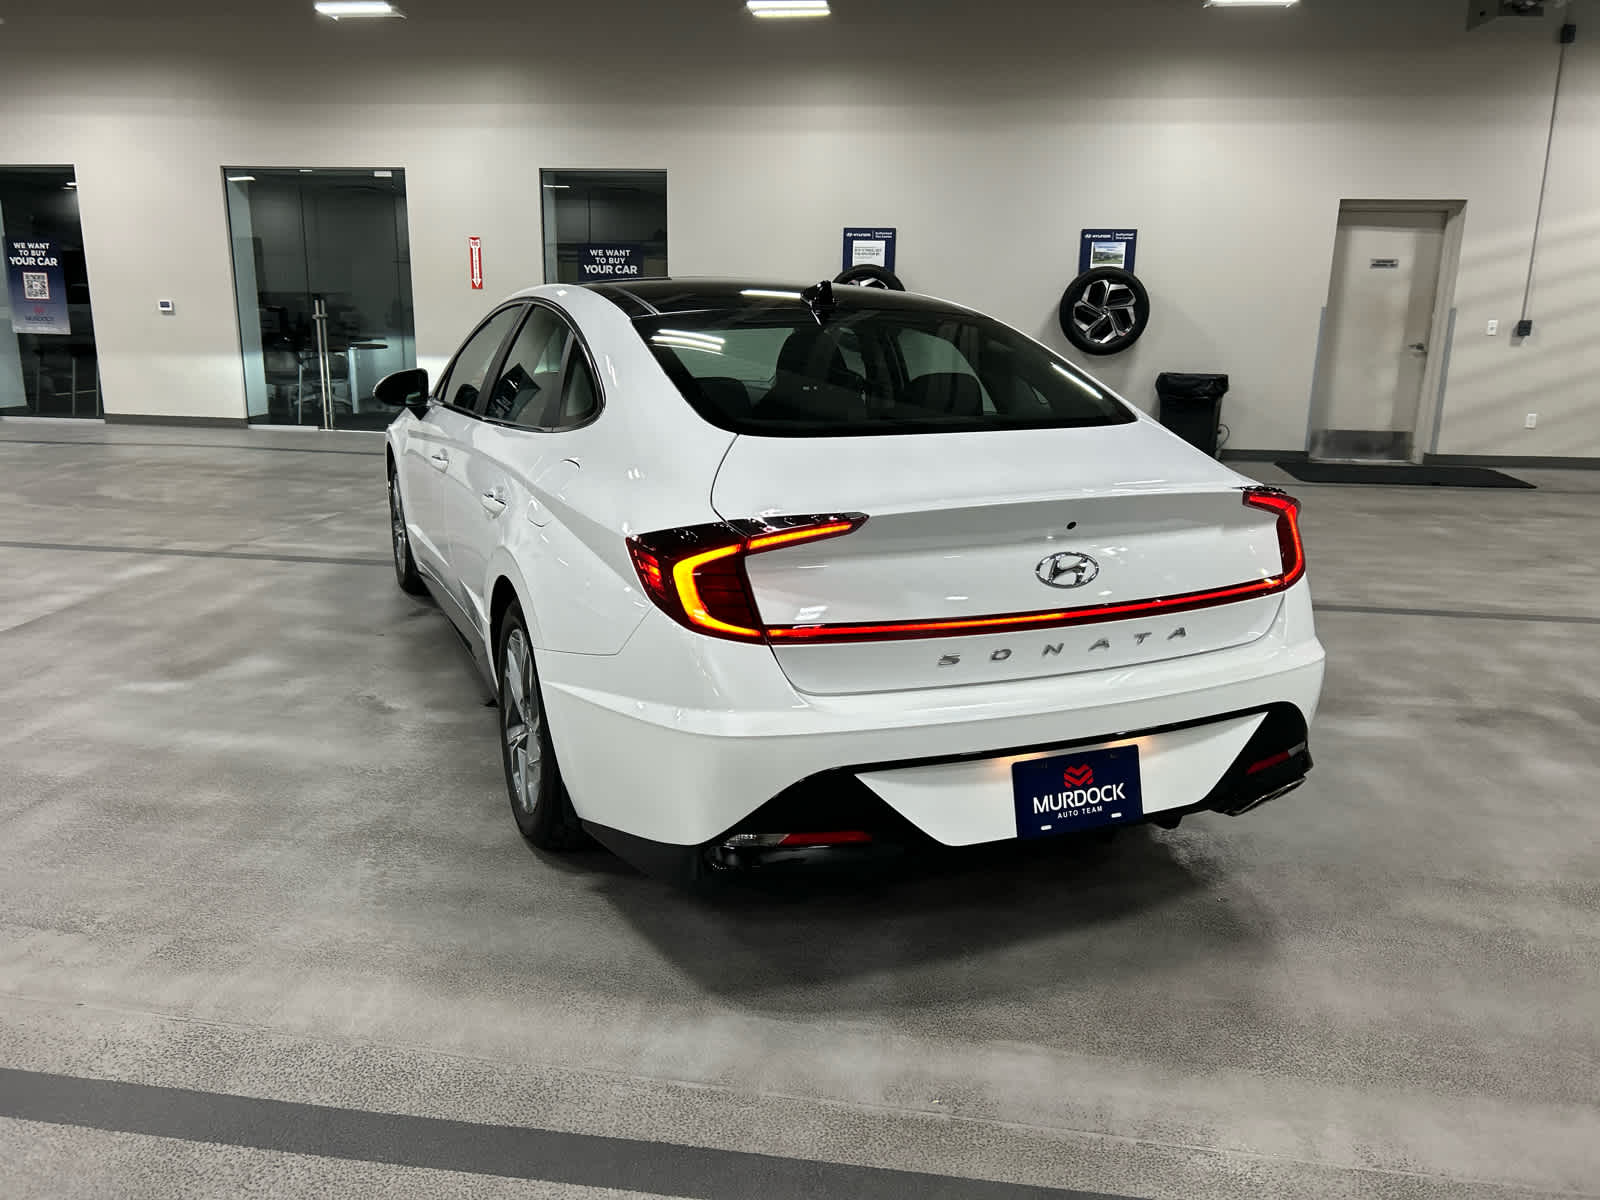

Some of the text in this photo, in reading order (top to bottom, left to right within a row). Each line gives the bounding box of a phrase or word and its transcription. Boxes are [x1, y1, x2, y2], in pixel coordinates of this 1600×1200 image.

[27, 242, 50, 250] WANT
[9, 257, 58, 266] YOUR CAR
[583, 264, 638, 274] YOUR CAR
[937, 626, 1188, 667] SONATA
[1032, 782, 1126, 814] MURDOCK
[1057, 805, 1103, 819] AUTO TEAM
